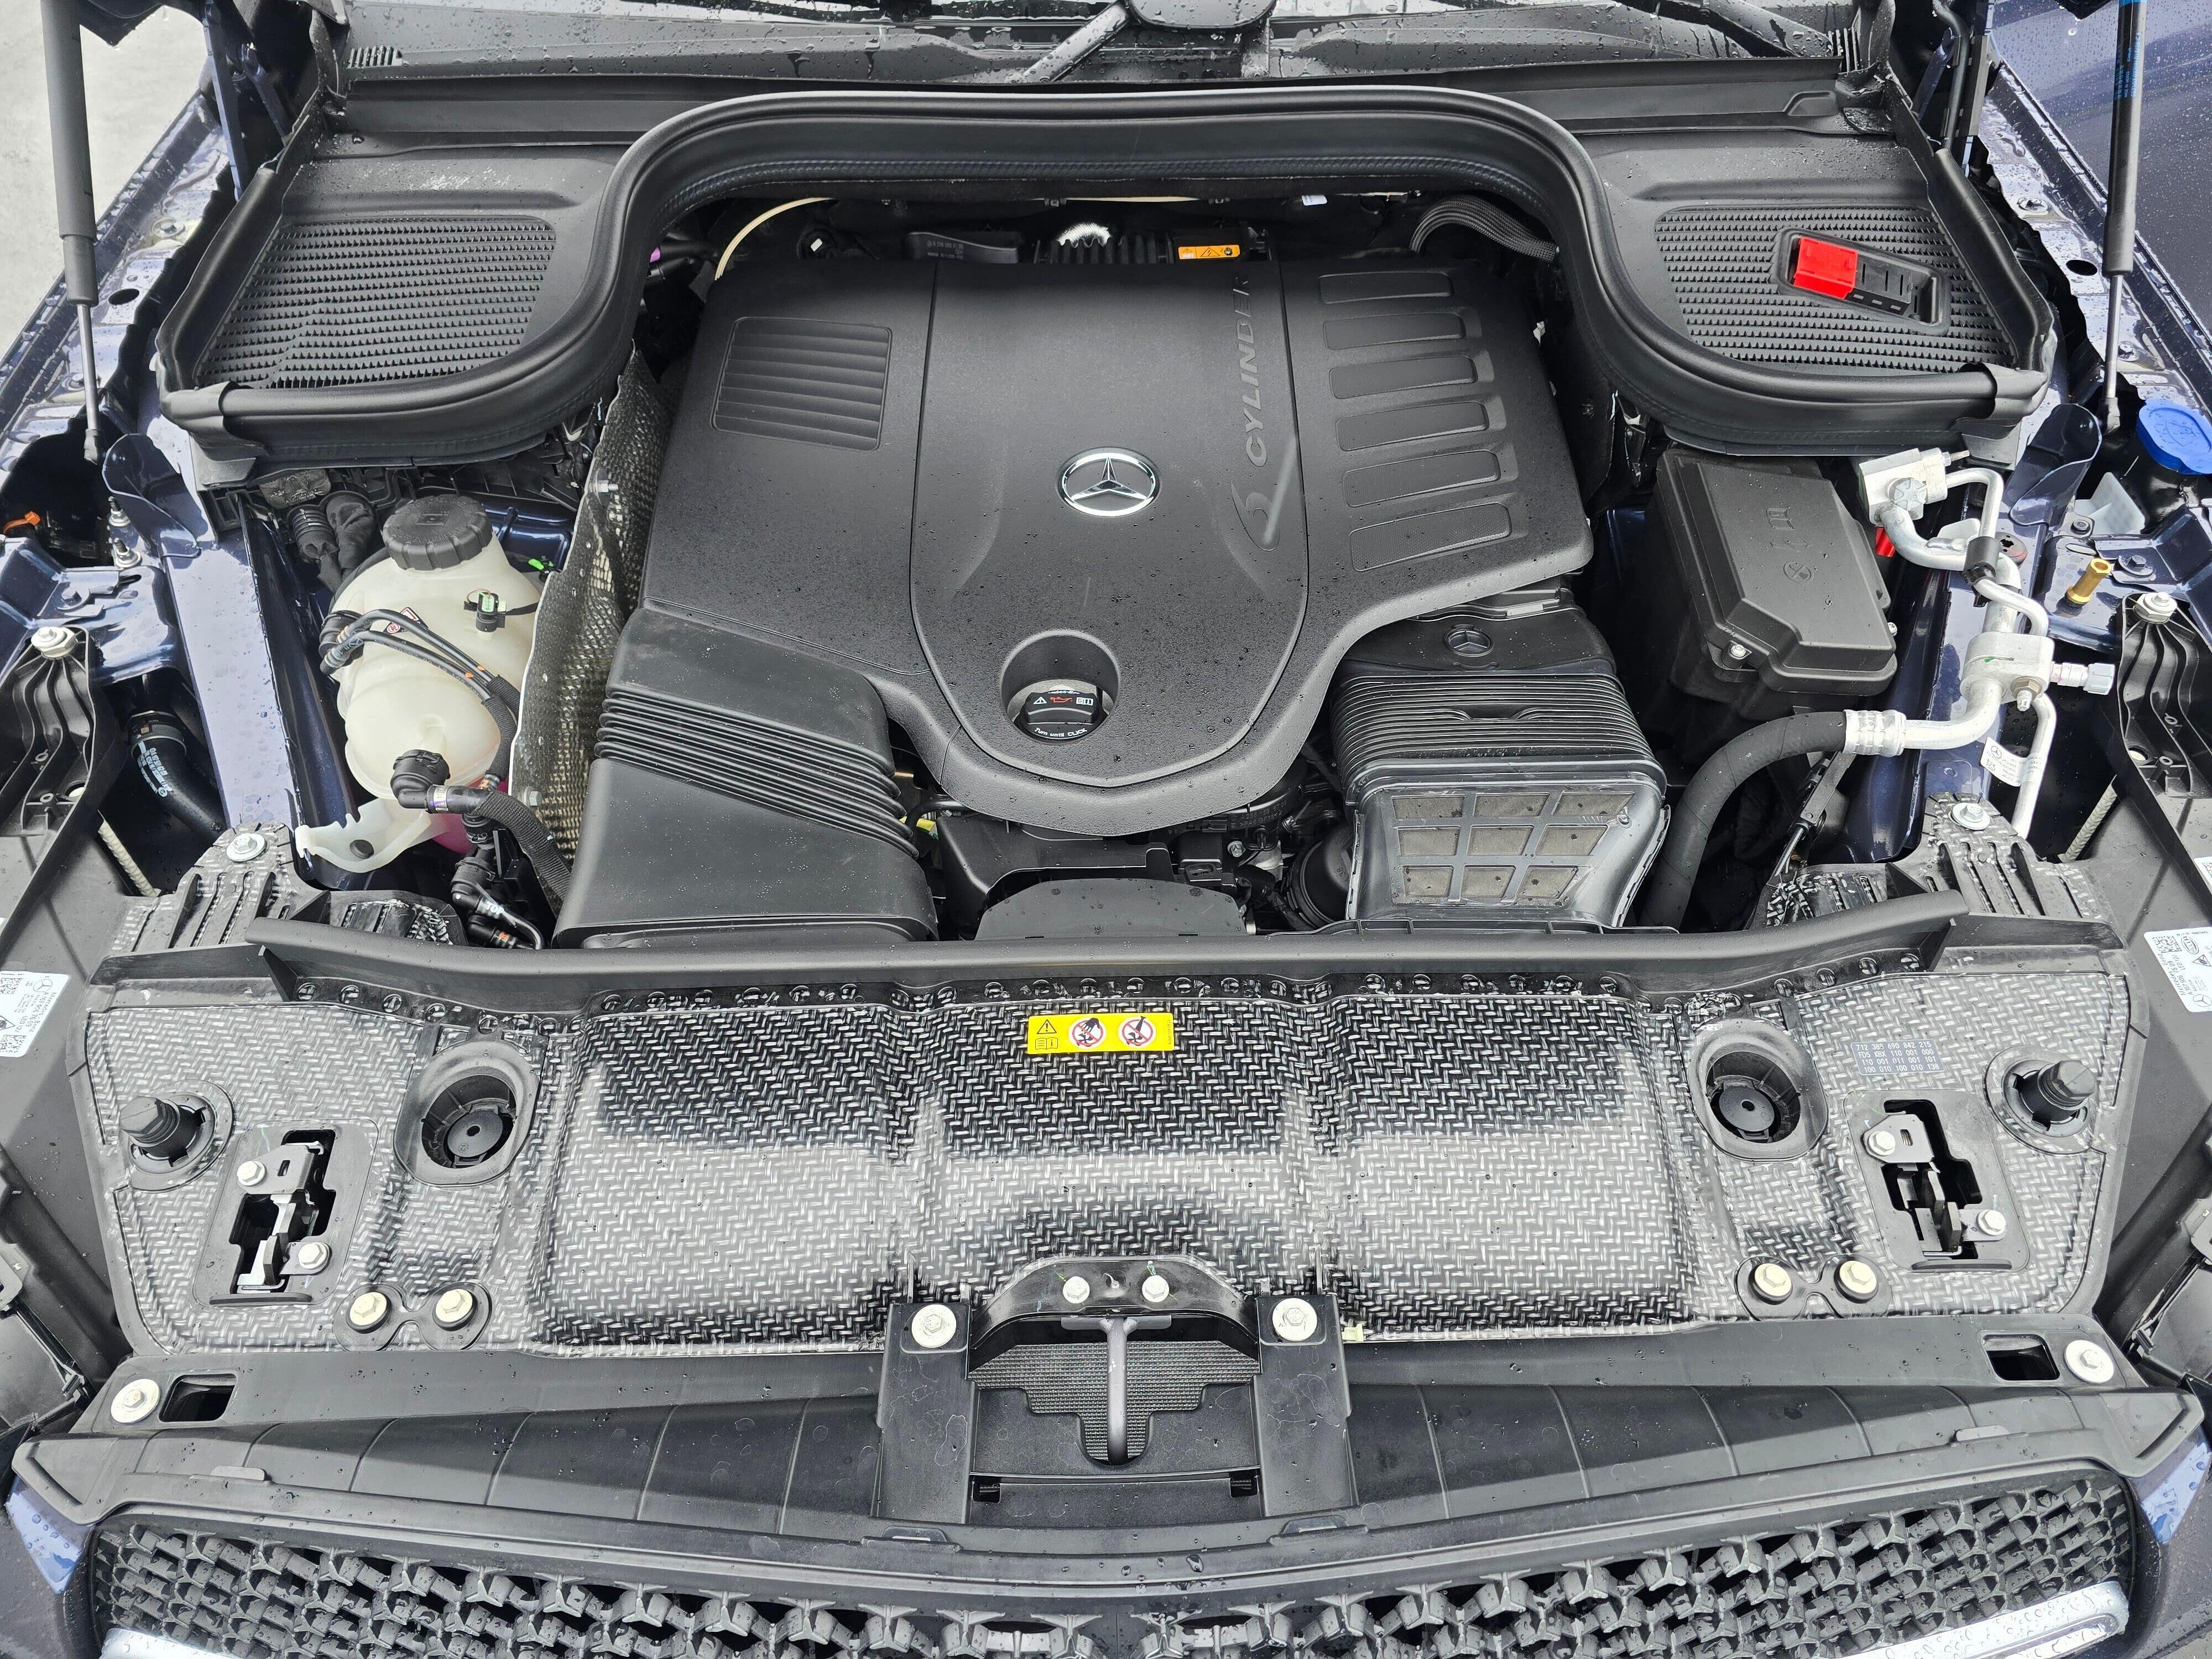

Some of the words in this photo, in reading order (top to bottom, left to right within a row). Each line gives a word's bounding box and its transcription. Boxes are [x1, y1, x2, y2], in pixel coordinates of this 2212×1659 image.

[1233, 275, 1267, 467] CYLINDER
[1034, 727, 1047, 735] Turn
[1067, 728, 1088, 737] CLICK
[486, 901, 504, 915] TOP
